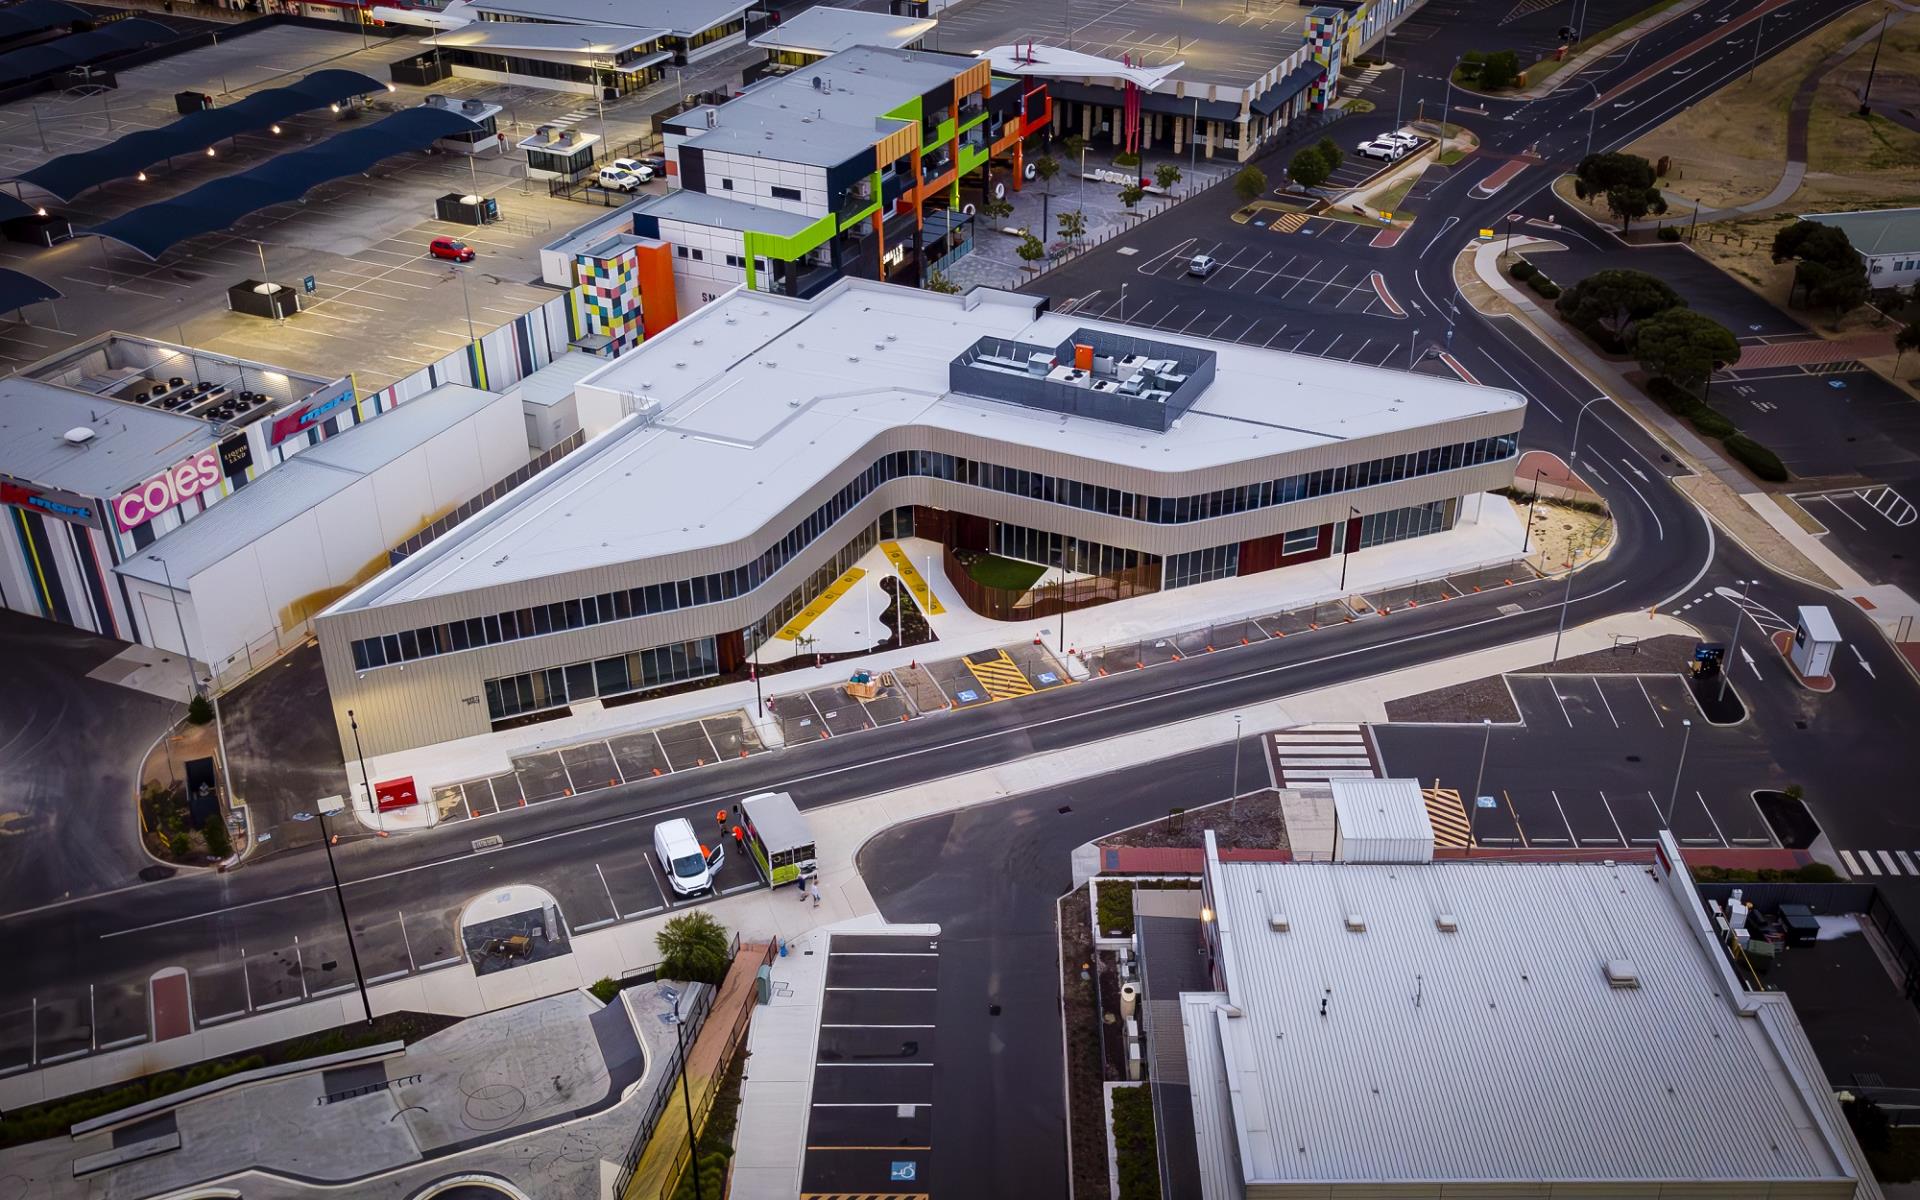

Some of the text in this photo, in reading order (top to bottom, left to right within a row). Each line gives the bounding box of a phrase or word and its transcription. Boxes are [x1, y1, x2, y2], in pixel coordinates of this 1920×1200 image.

[224, 445, 247, 459] LIQUOR
[228, 453, 246, 464] LAND
[119, 454, 219, 527] coles
